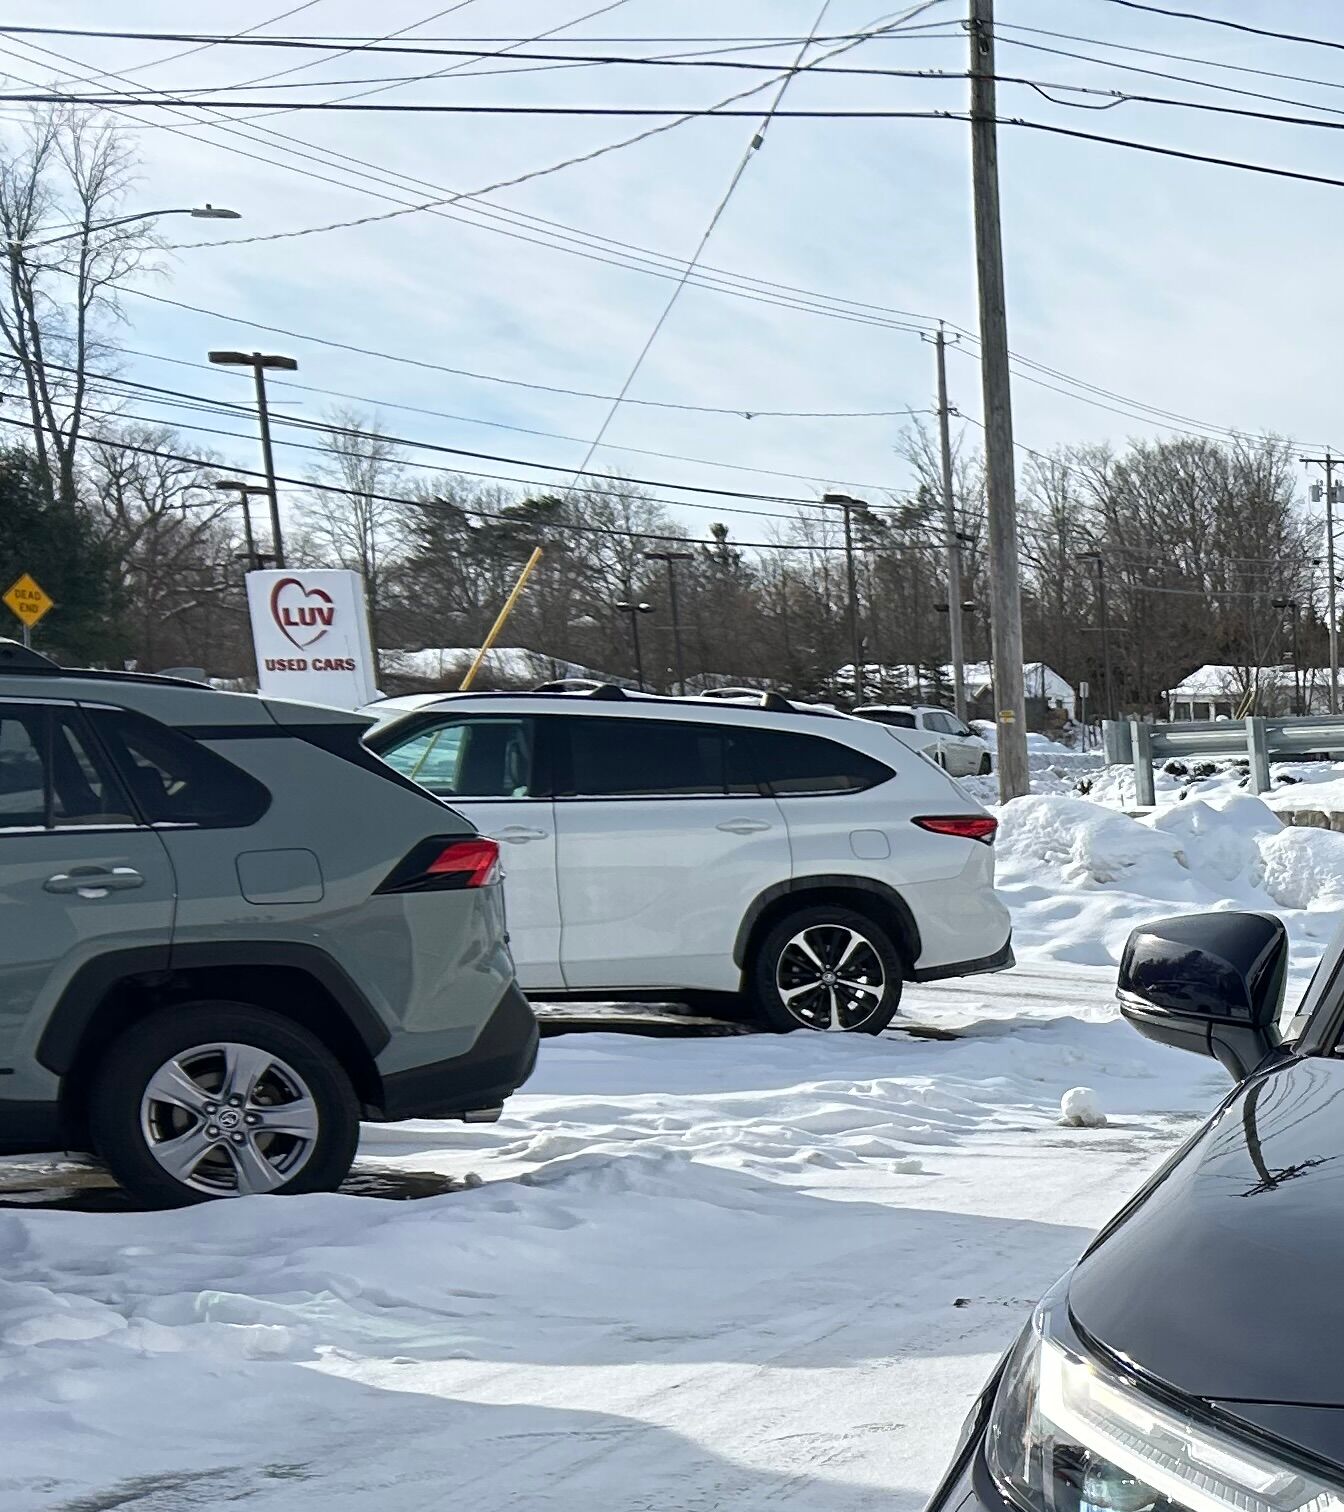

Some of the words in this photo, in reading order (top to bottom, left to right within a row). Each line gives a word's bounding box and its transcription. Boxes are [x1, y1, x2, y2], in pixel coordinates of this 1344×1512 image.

[15, 589, 41, 601] DEAD
[281, 607, 335, 626] LUV
[265, 658, 307, 672] USED
[312, 658, 356, 672] CARS
